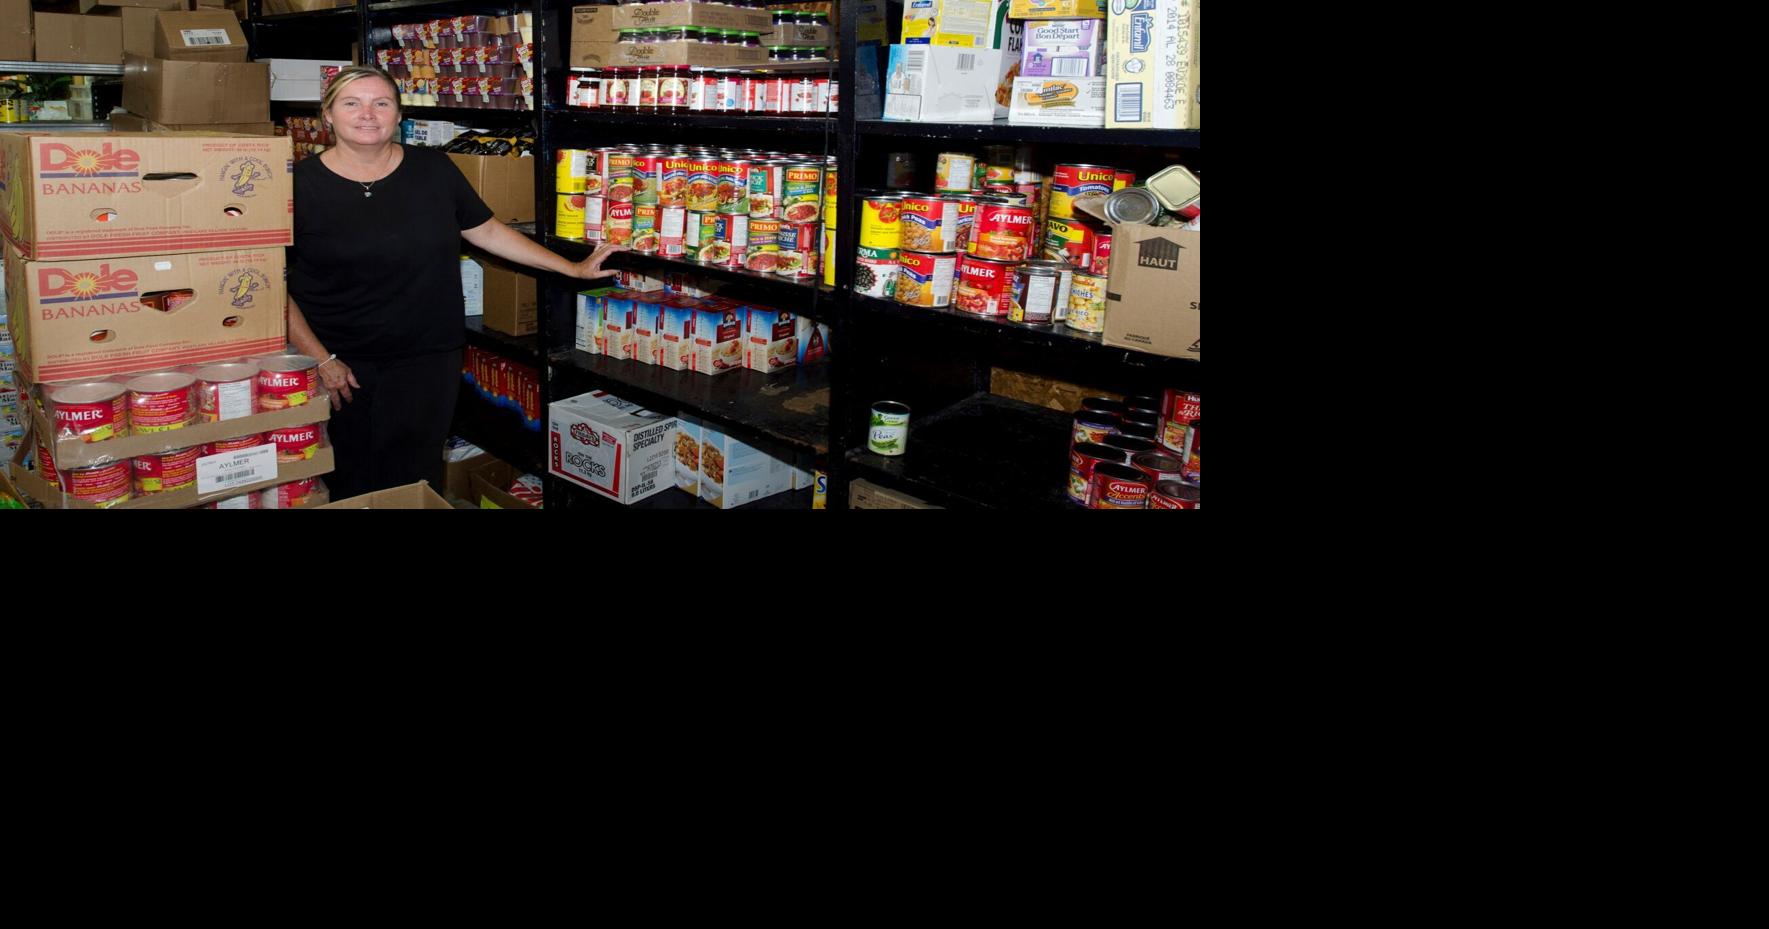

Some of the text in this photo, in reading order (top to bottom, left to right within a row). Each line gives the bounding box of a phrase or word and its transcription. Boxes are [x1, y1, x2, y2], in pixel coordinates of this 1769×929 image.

[1166, 6, 1178, 30] 2014
[1052, 32, 1080, 41] Départ
[1165, 54, 1176, 67] 28
[39, 142, 141, 174] Dole
[688, 162, 717, 173] Unico
[788, 171, 818, 180] PRIMO
[1077, 171, 1114, 182] Unico
[42, 181, 142, 195] BANANAS
[989, 213, 1032, 224] AYLMER
[750, 222, 778, 231] PRIMO
[1048, 222, 1068, 234] AVO
[900, 256, 920, 267] nico
[1140, 256, 1176, 269] HAUT
[959, 263, 995, 279] AYLMER
[38, 263, 139, 298] Dole
[42, 301, 141, 320] BANANAS
[258, 376, 299, 388] AYLMER
[54, 409, 104, 422] AYLMER
[268, 431, 314, 443] AYLMER
[633, 425, 663, 443] DISTILLED
[873, 429, 894, 440] Peas
[632, 433, 665, 452] SPECIALTY
[218, 457, 250, 470] AYLMER
[565, 450, 606, 478] ROCKS
[1113, 484, 1146, 494] AYLMER
[1106, 491, 1146, 500] Accents
